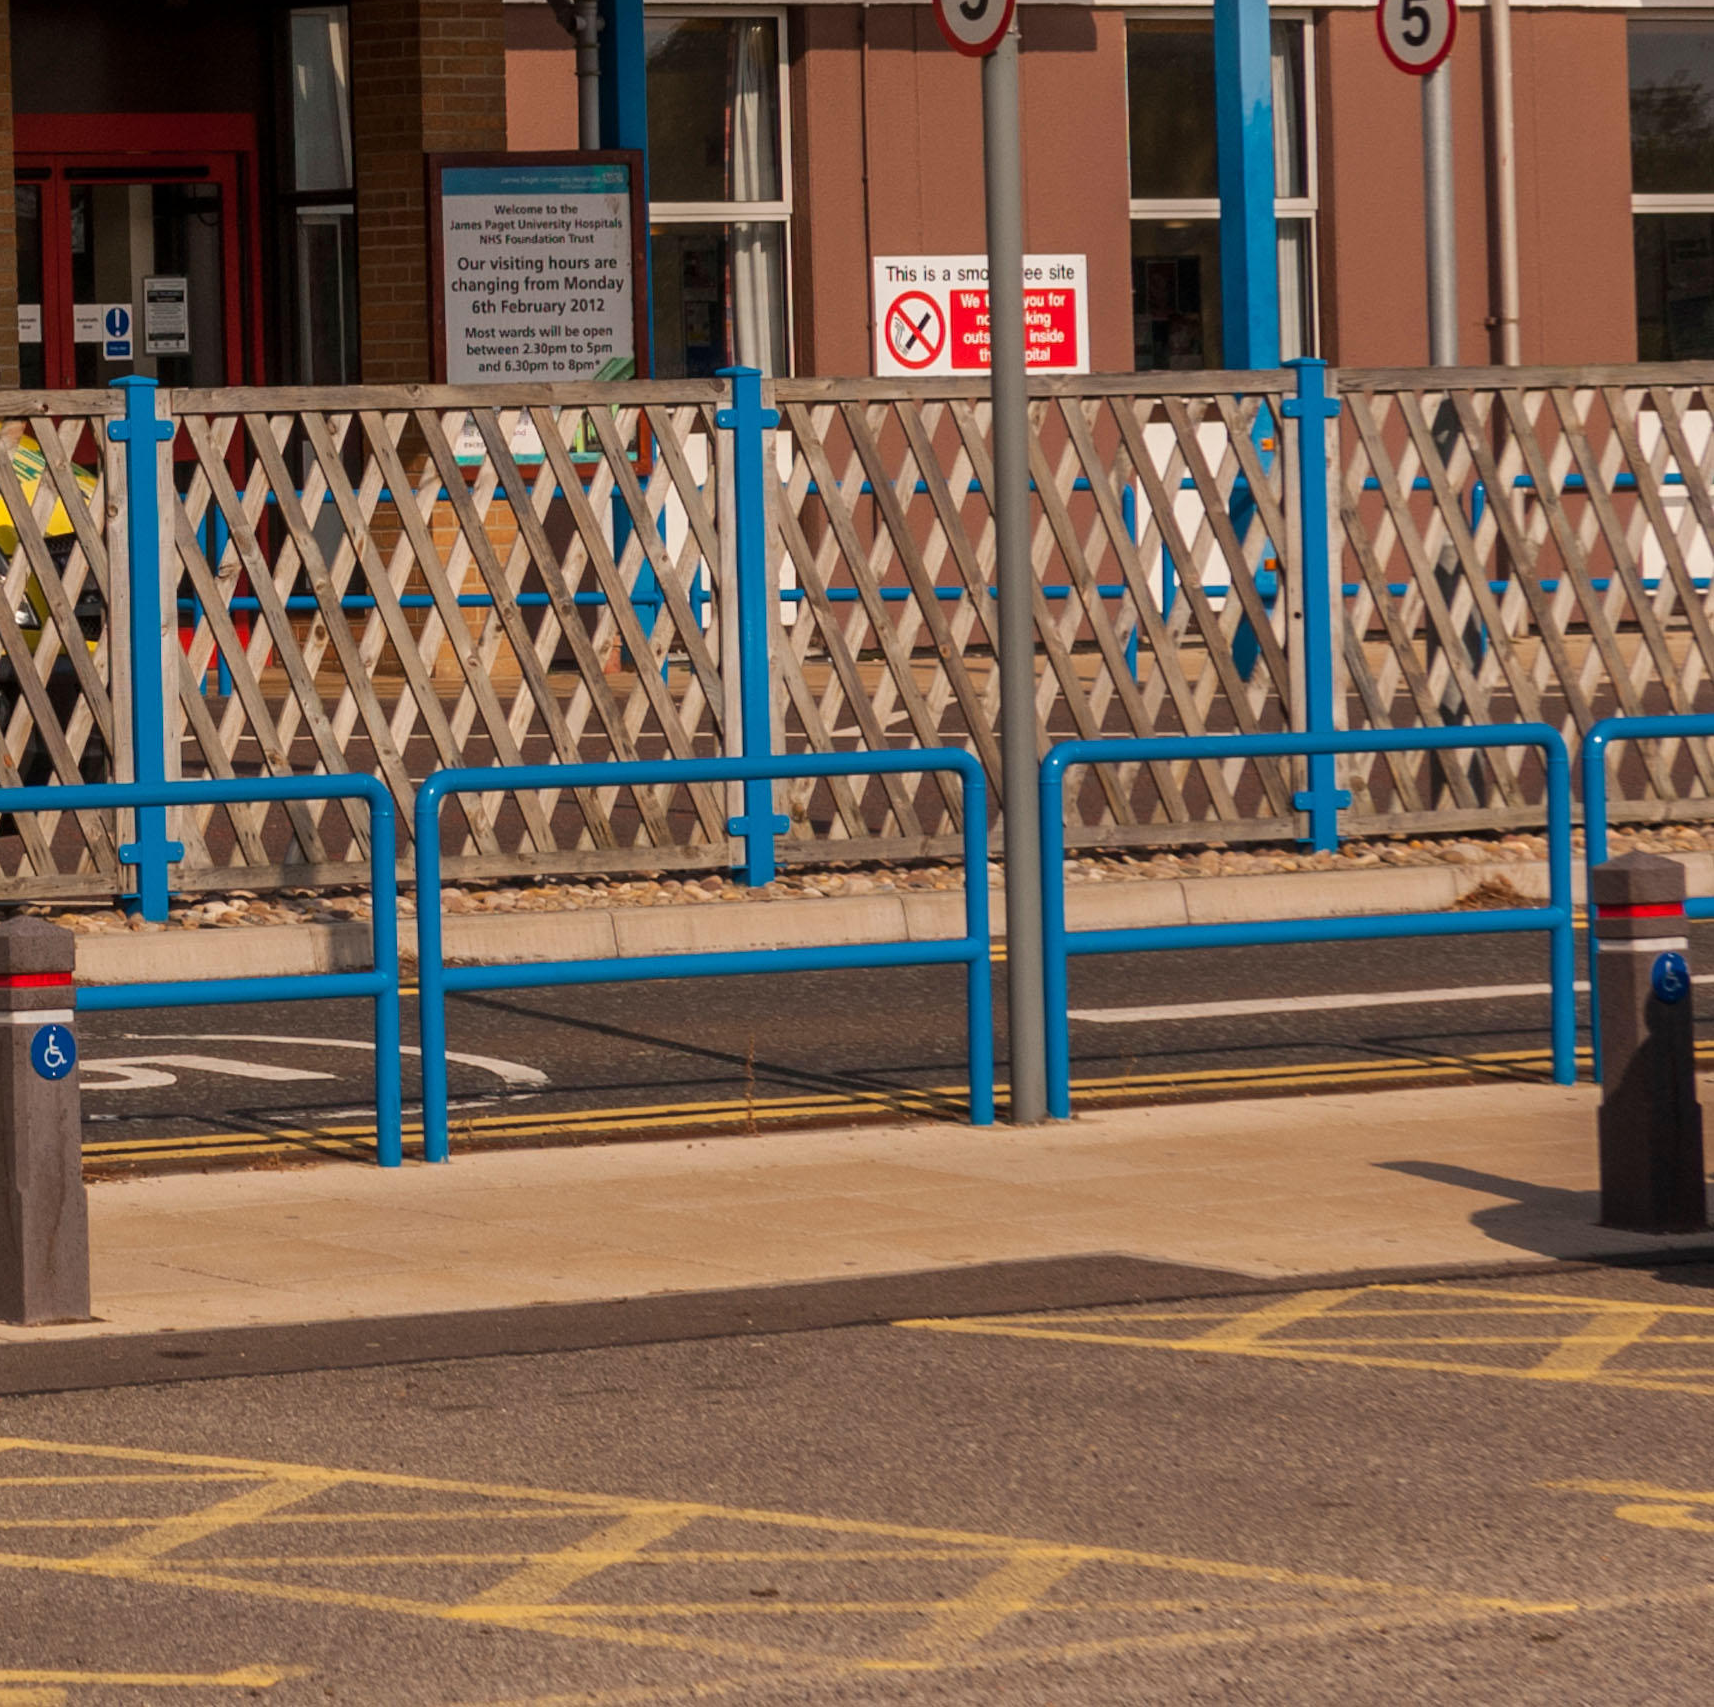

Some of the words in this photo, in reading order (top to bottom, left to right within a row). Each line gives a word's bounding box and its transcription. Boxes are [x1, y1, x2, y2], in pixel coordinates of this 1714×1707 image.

[494, 204, 543, 215] Welcome
[546, 206, 557, 215] to
[560, 204, 578, 214] the
[450, 220, 482, 231] James
[484, 220, 515, 233] Paget
[518, 219, 572, 232] University
[574, 218, 623, 230] Hospitals
[479, 235, 502, 245] NHS
[505, 234, 566, 244] Foundation
[568, 234, 595, 244] Trust
[457, 257, 486, 271] Our
[490, 256, 544, 273] visiting
[548, 256, 590, 270] hours
[594, 258, 618, 269] are
[885, 265, 917, 282] This
[923, 265, 936, 281] is
[942, 269, 951, 281] a
[957, 268, 989, 281] smo
[1024, 268, 1043, 280] ee
[1049, 264, 1075, 280] site
[451, 278, 520, 294] changing
[524, 276, 560, 291] from
[564, 276, 624, 293] Monday
[471, 300, 496, 314] 6th
[501, 299, 566, 316] February
[570, 298, 605, 312] 2012
[960, 294, 980, 309] We
[1024, 296, 1045, 309] you
[1048, 293, 1066, 307] for
[976, 313, 990, 326] no
[1025, 311, 1052, 327] king
[465, 327, 496, 339] Most
[499, 326, 536, 338] wards
[539, 325, 561, 337] will
[565, 325, 579, 337] be
[583, 328, 613, 339] open
[963, 330, 990, 345] outs
[1029, 329, 1065, 343] inside
[466, 344, 519, 355] between
[523, 343, 567, 356] 2.30pm
[570, 344, 583, 354] to
[587, 343, 613, 356] 5pm
[979, 348, 991, 362] th
[1024, 348, 1051, 364] pital
[478, 360, 501, 372] and
[504, 360, 549, 374] 6.30pm
[552, 361, 565, 371] to
